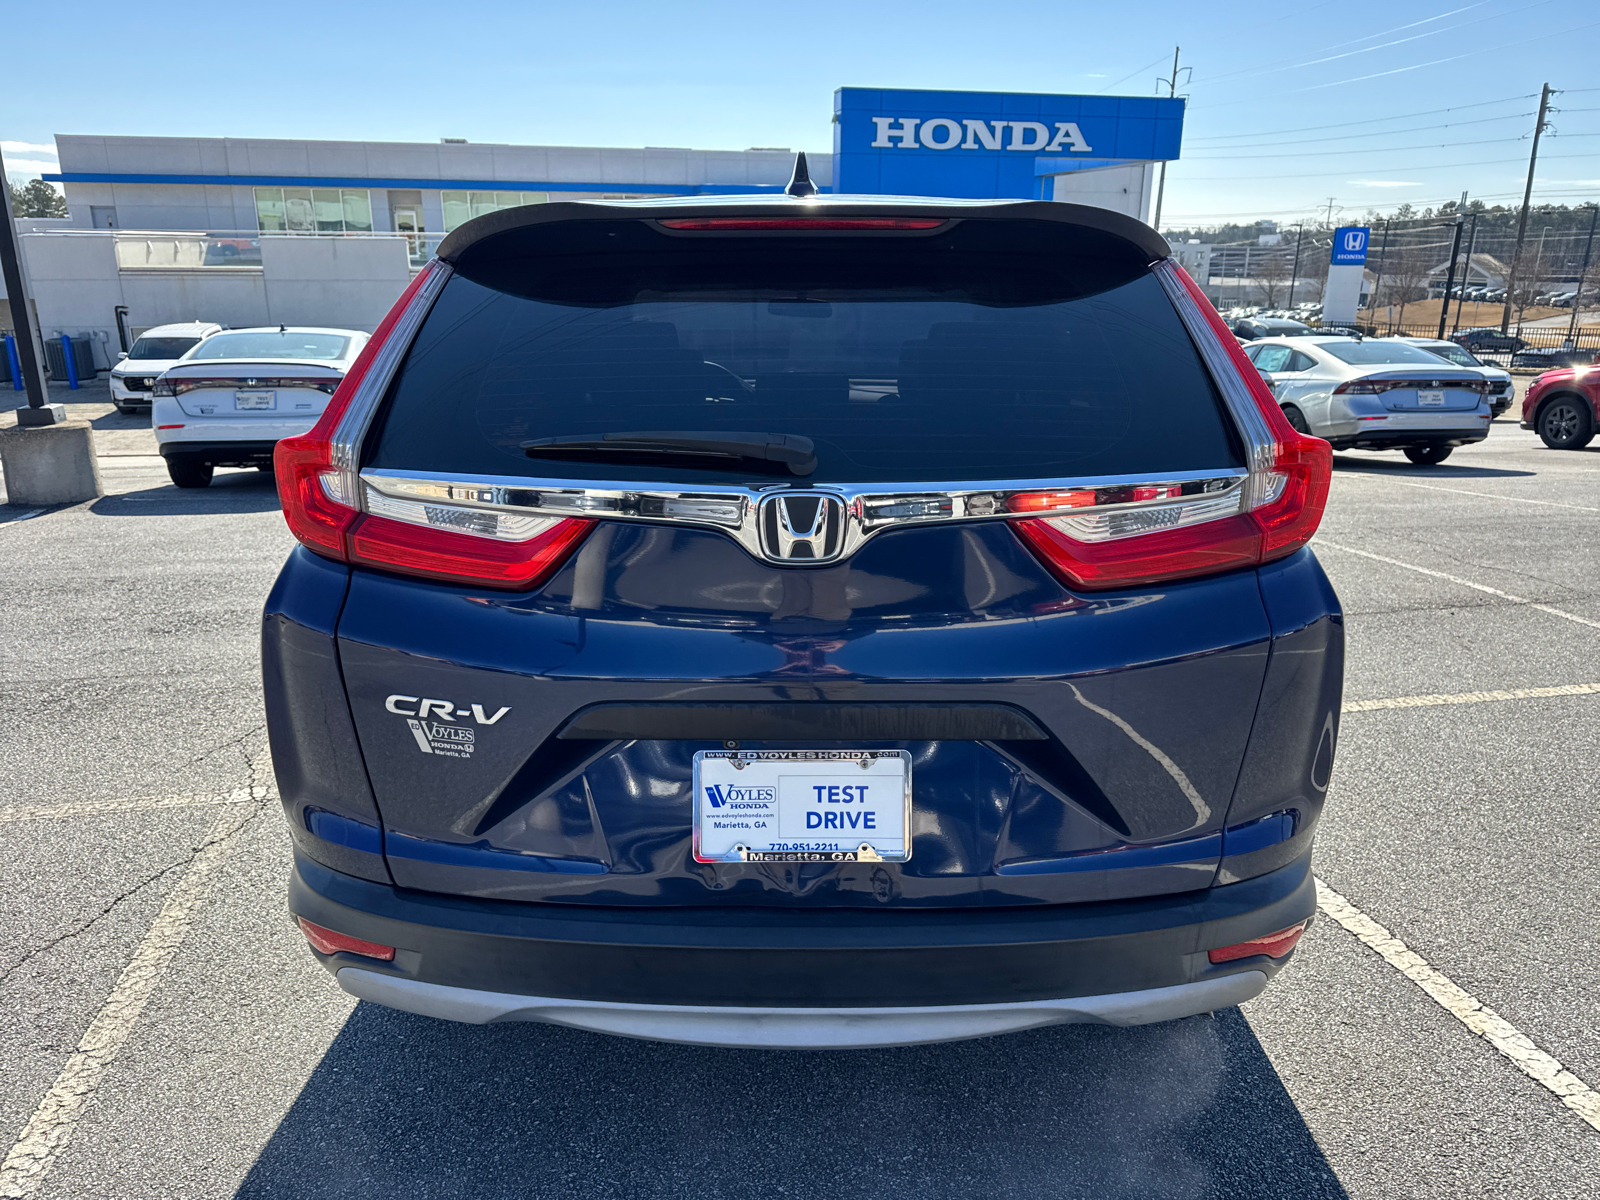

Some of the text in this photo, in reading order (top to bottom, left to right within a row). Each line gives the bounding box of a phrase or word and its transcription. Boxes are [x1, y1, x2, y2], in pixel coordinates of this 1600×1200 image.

[871, 116, 1093, 152] HONDA
[385, 694, 513, 725] CR-V
[420, 720, 474, 742] VOYLES
[430, 741, 464, 751] HONDA
[434, 749, 460, 758] Marietta,
[713, 784, 774, 806] VOYLES
[813, 785, 869, 803] TEST
[713, 821, 767, 829] Marietta, GA
[806, 811, 876, 829] DRIVE
[749, 852, 855, 861] Marietta, GA
